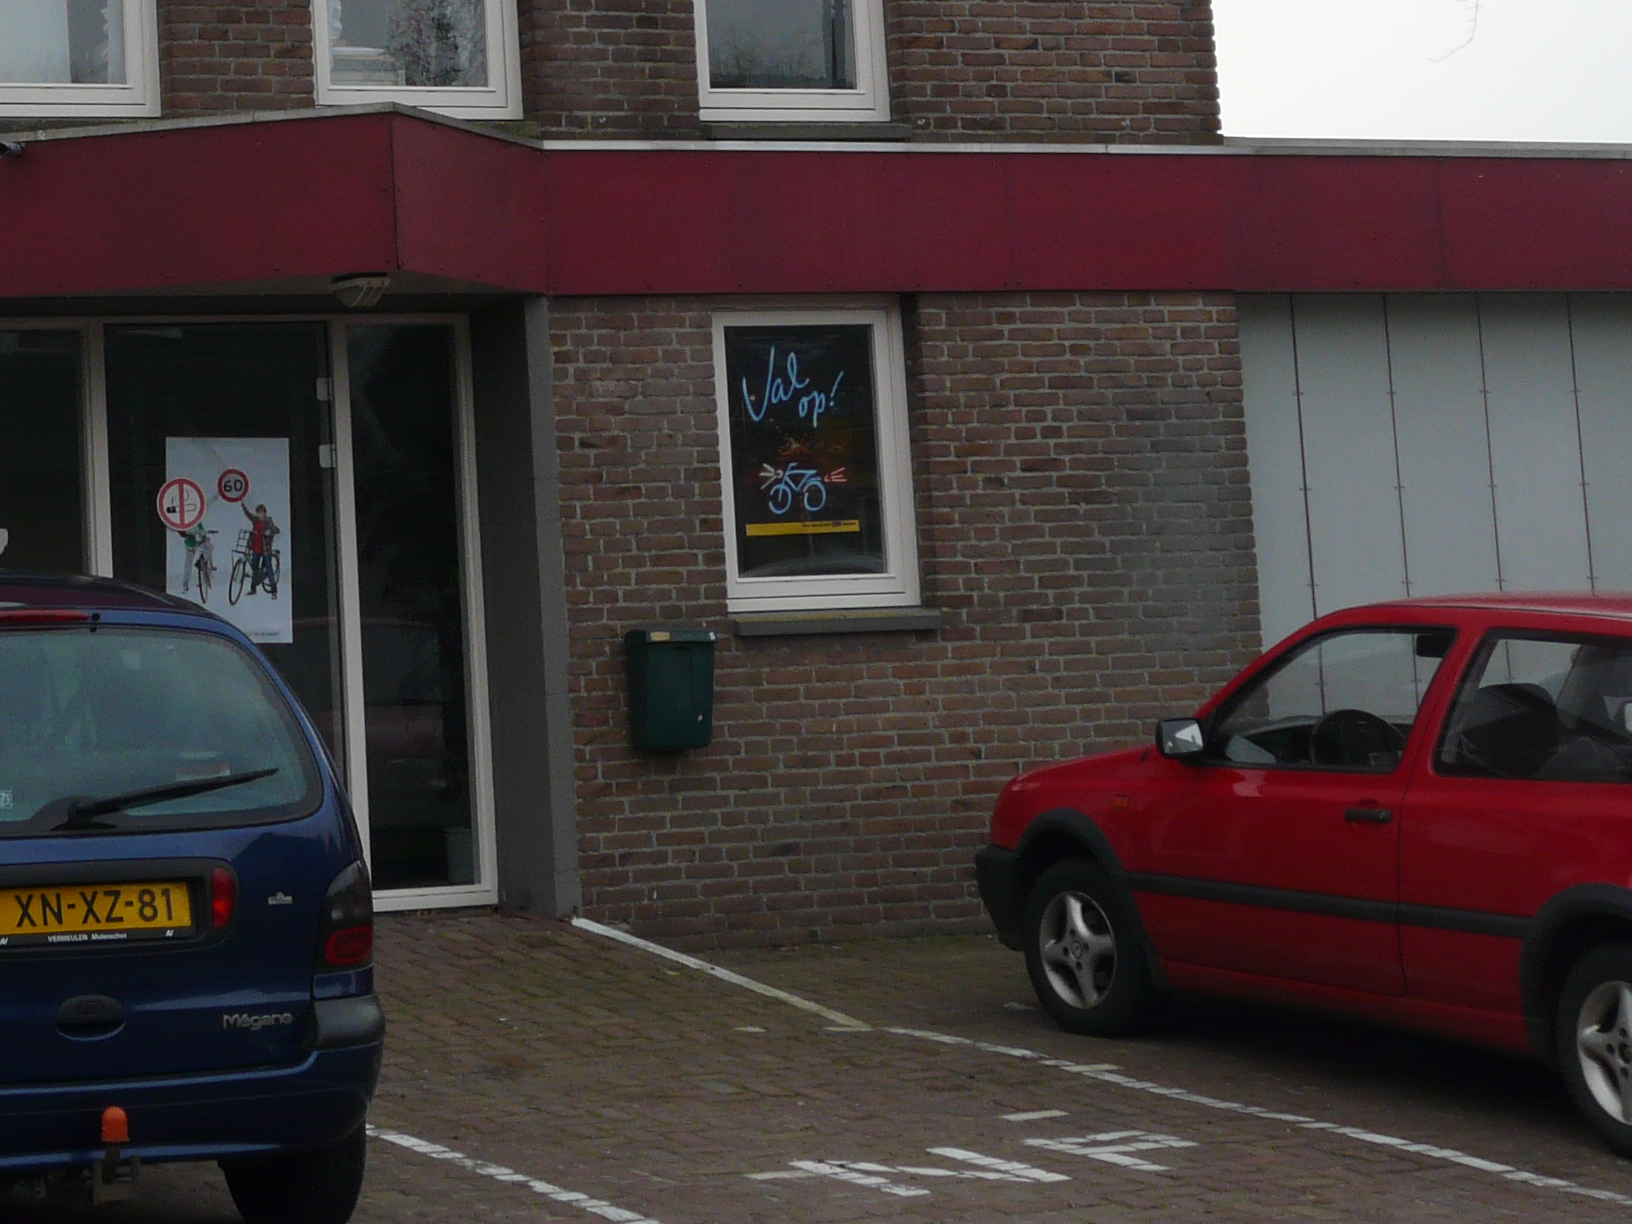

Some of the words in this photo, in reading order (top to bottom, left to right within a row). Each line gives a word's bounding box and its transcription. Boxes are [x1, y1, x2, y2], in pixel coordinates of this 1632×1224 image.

[742, 345, 810, 423] Val
[798, 371, 845, 428] op!
[223, 479, 244, 493] 60
[14, 887, 174, 929] XN-XZ-81
[222, 1012, 293, 1030] Mégane
